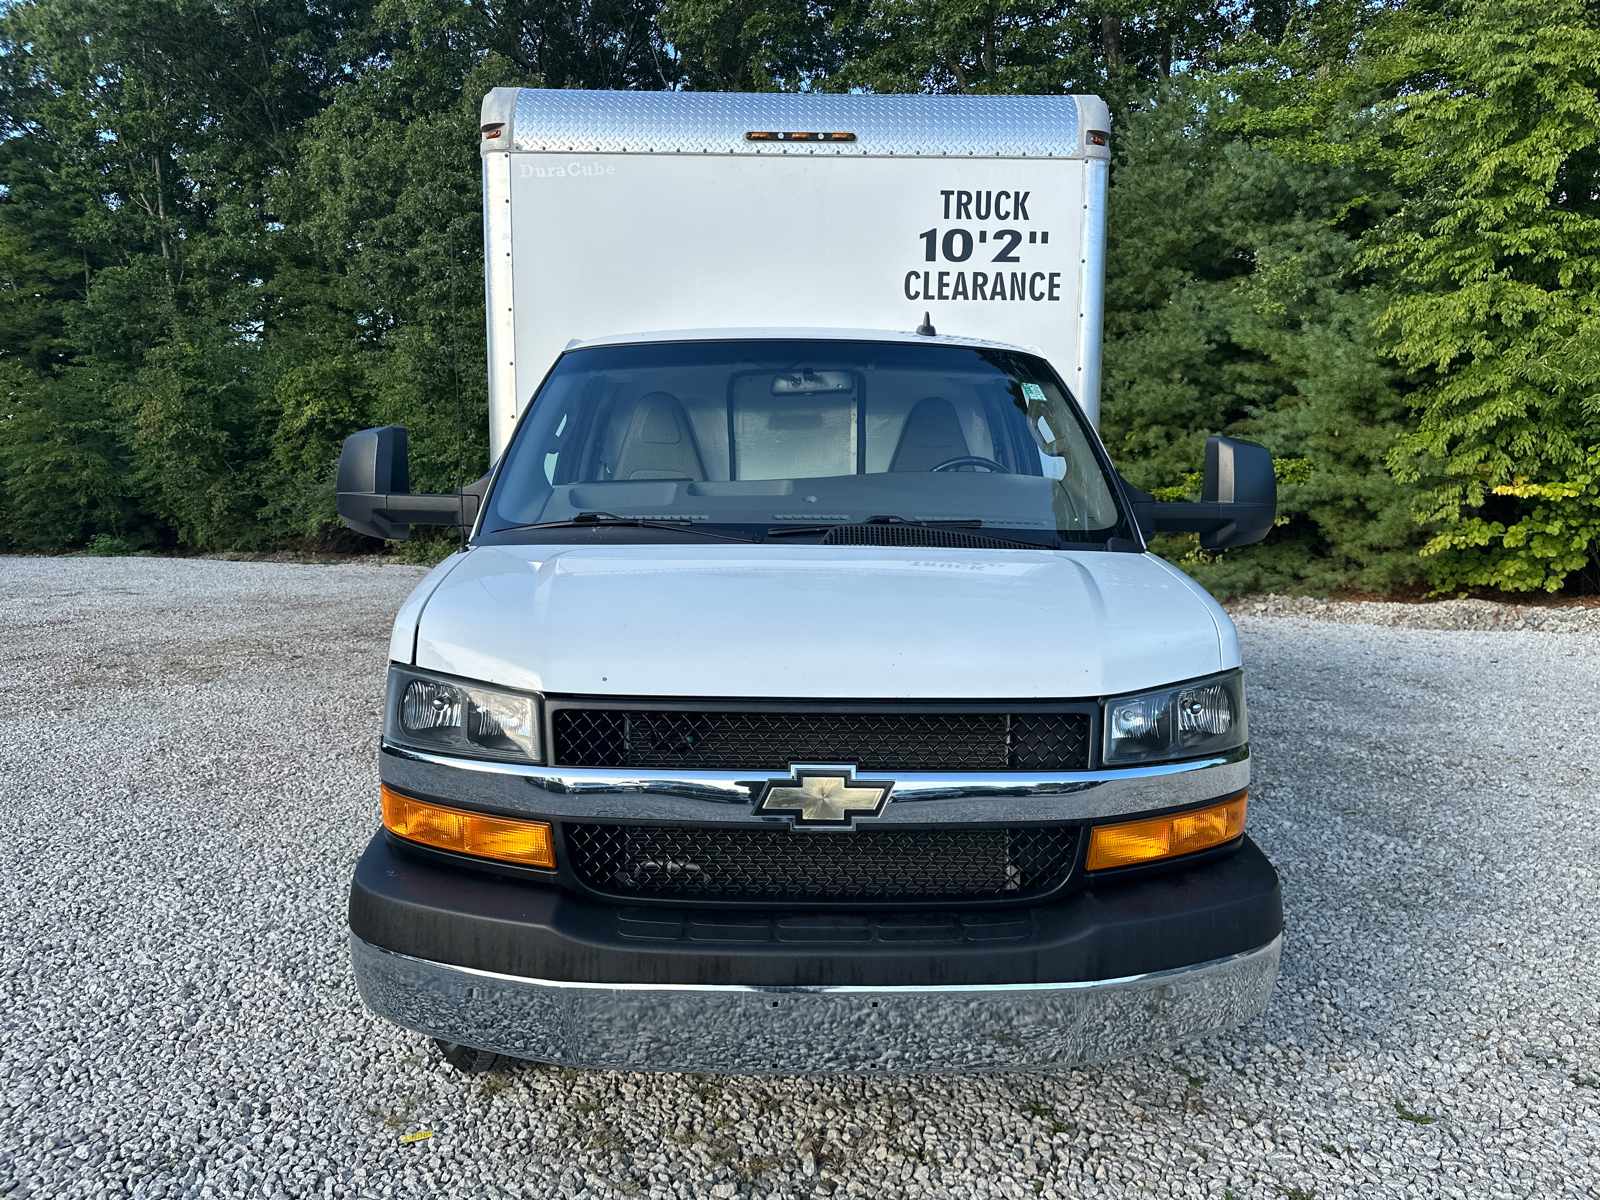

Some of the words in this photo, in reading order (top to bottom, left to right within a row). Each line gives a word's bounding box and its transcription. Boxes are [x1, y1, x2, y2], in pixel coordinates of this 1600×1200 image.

[519, 162, 616, 179] DuraCube
[940, 190, 1031, 221] TRUCK
[919, 228, 1049, 263] 10'2"
[904, 270, 1061, 302] CLEARANCE
